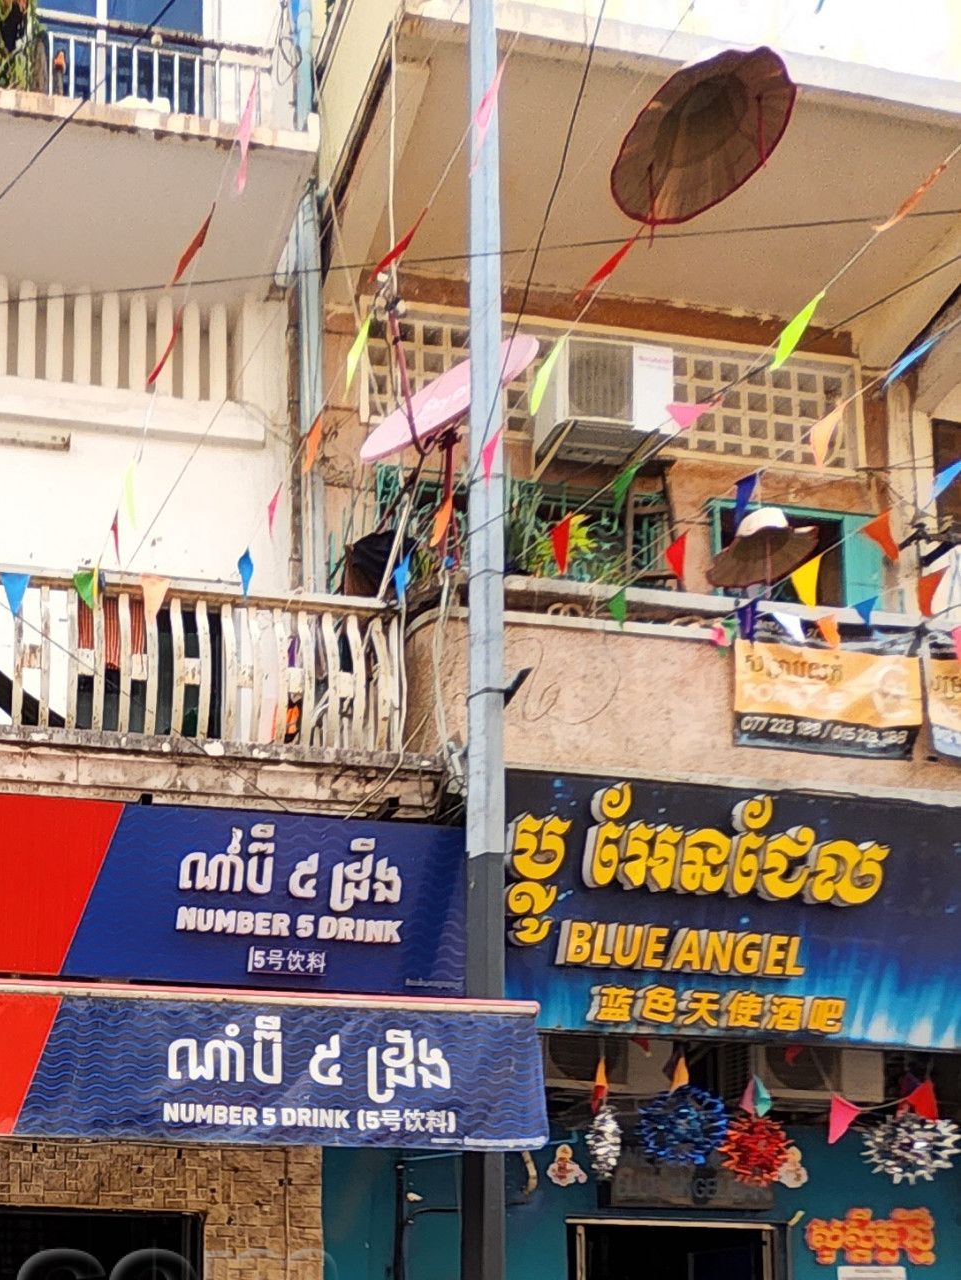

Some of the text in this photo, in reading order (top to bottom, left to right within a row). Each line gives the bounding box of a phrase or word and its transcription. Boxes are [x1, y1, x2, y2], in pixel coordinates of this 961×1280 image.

[175, 906, 404, 944] NUMBER 5 DRINK
[557, 919, 806, 978] BLUE ANGEL
[590, 984, 847, 1035] 蓝色天使酒吧
[163, 1102, 257, 1127] NUMBER
[262, 1107, 276, 1127] 5
[281, 1107, 350, 1130] DRINK
